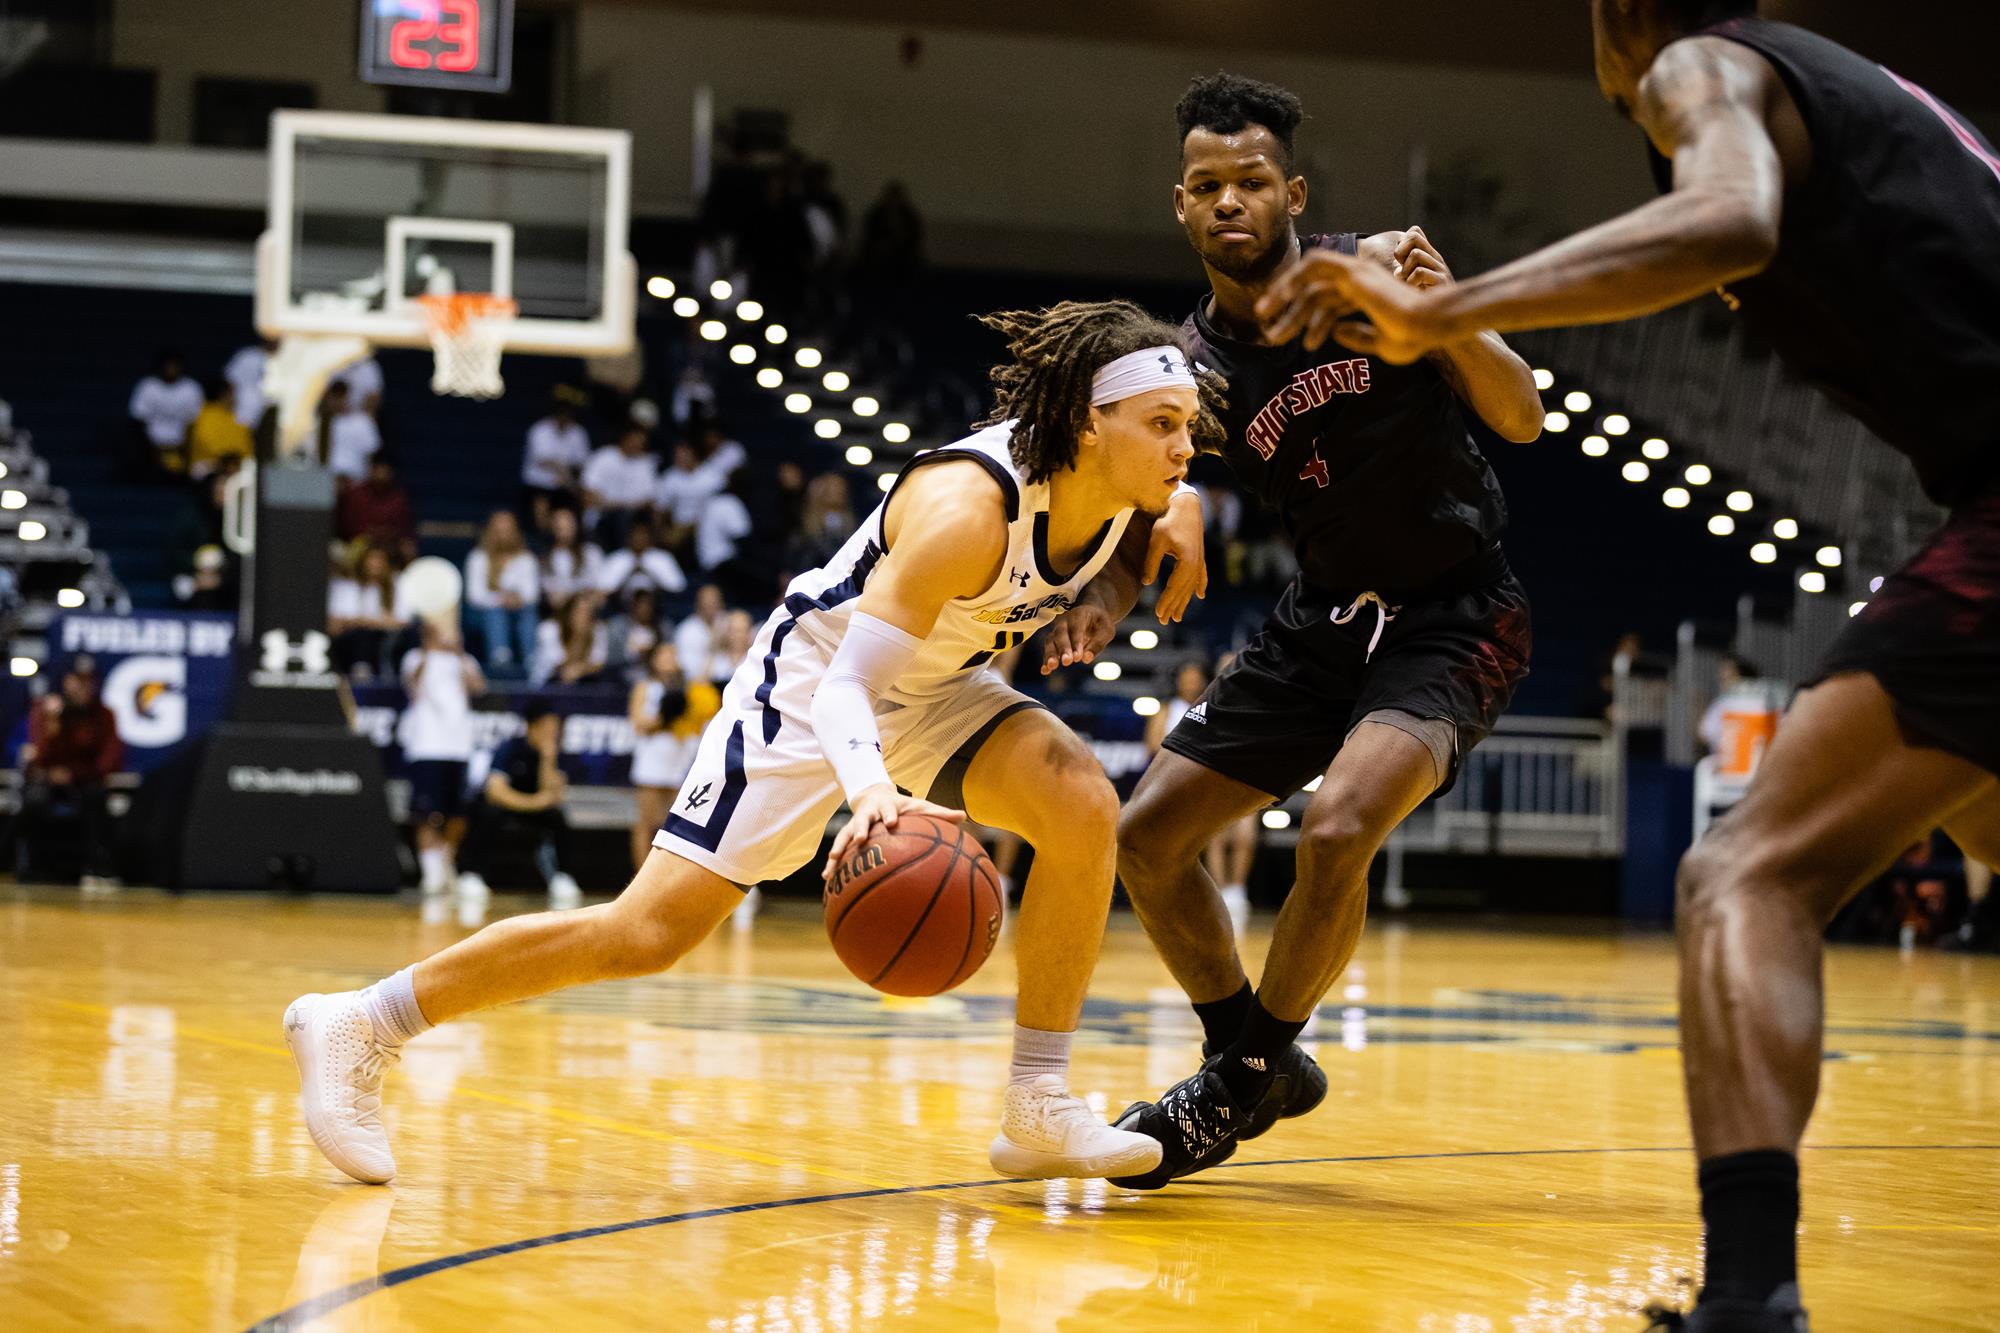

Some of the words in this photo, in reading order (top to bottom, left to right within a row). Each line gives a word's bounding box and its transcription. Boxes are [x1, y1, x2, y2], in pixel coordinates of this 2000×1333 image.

[389, 0, 479, 72] 23
[1290, 358, 1371, 416] STATE
[1299, 437, 1330, 488] 4
[62, 616, 186, 654] FUELED
[188, 619, 235, 657] BY
[103, 656, 187, 748] G
